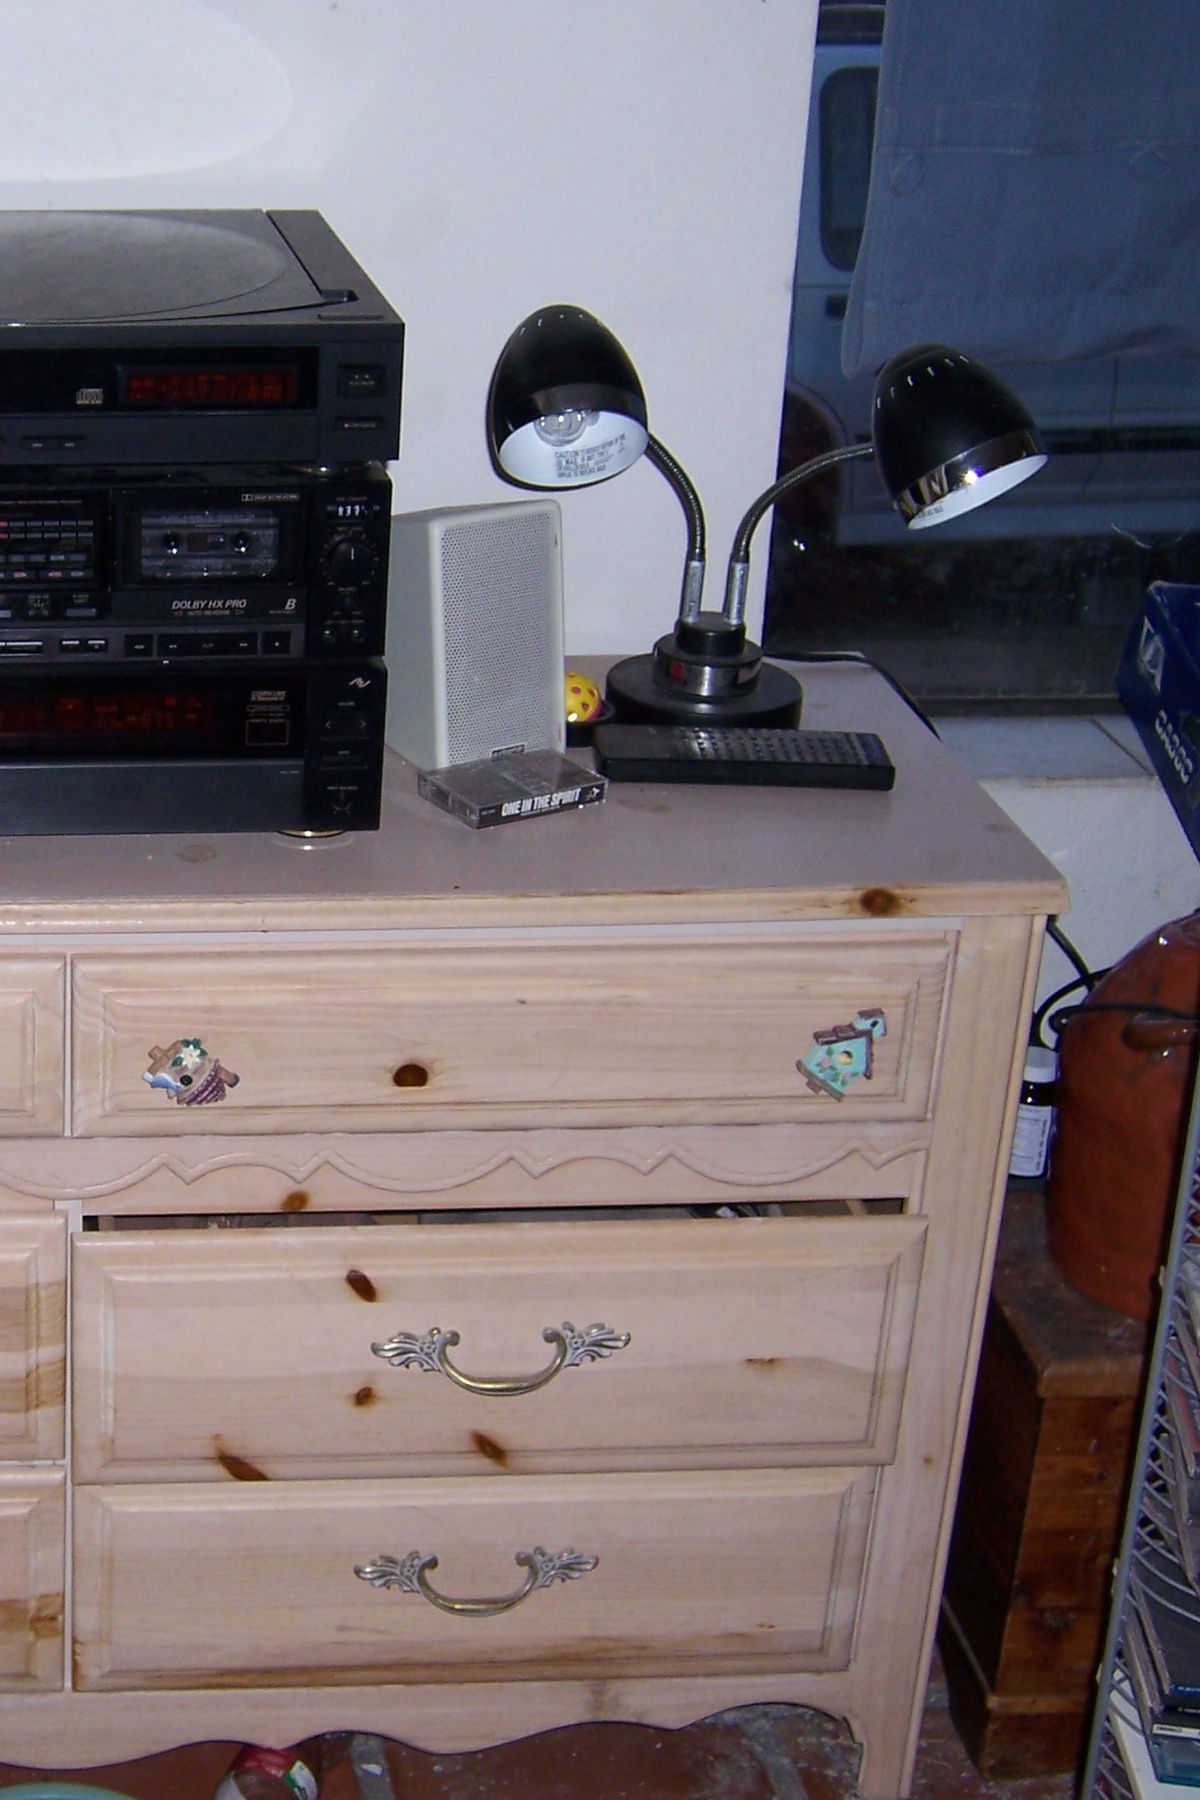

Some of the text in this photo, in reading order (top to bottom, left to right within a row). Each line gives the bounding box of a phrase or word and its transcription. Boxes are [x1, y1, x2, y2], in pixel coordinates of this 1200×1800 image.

[171, 599, 247, 610] DOLBY HX PRO
[285, 598, 297, 610] B
[501, 800, 521, 817] ONE
[521, 797, 533, 813] IN
[533, 794, 551, 810] THE
[551, 787, 582, 807] SPIRIT
